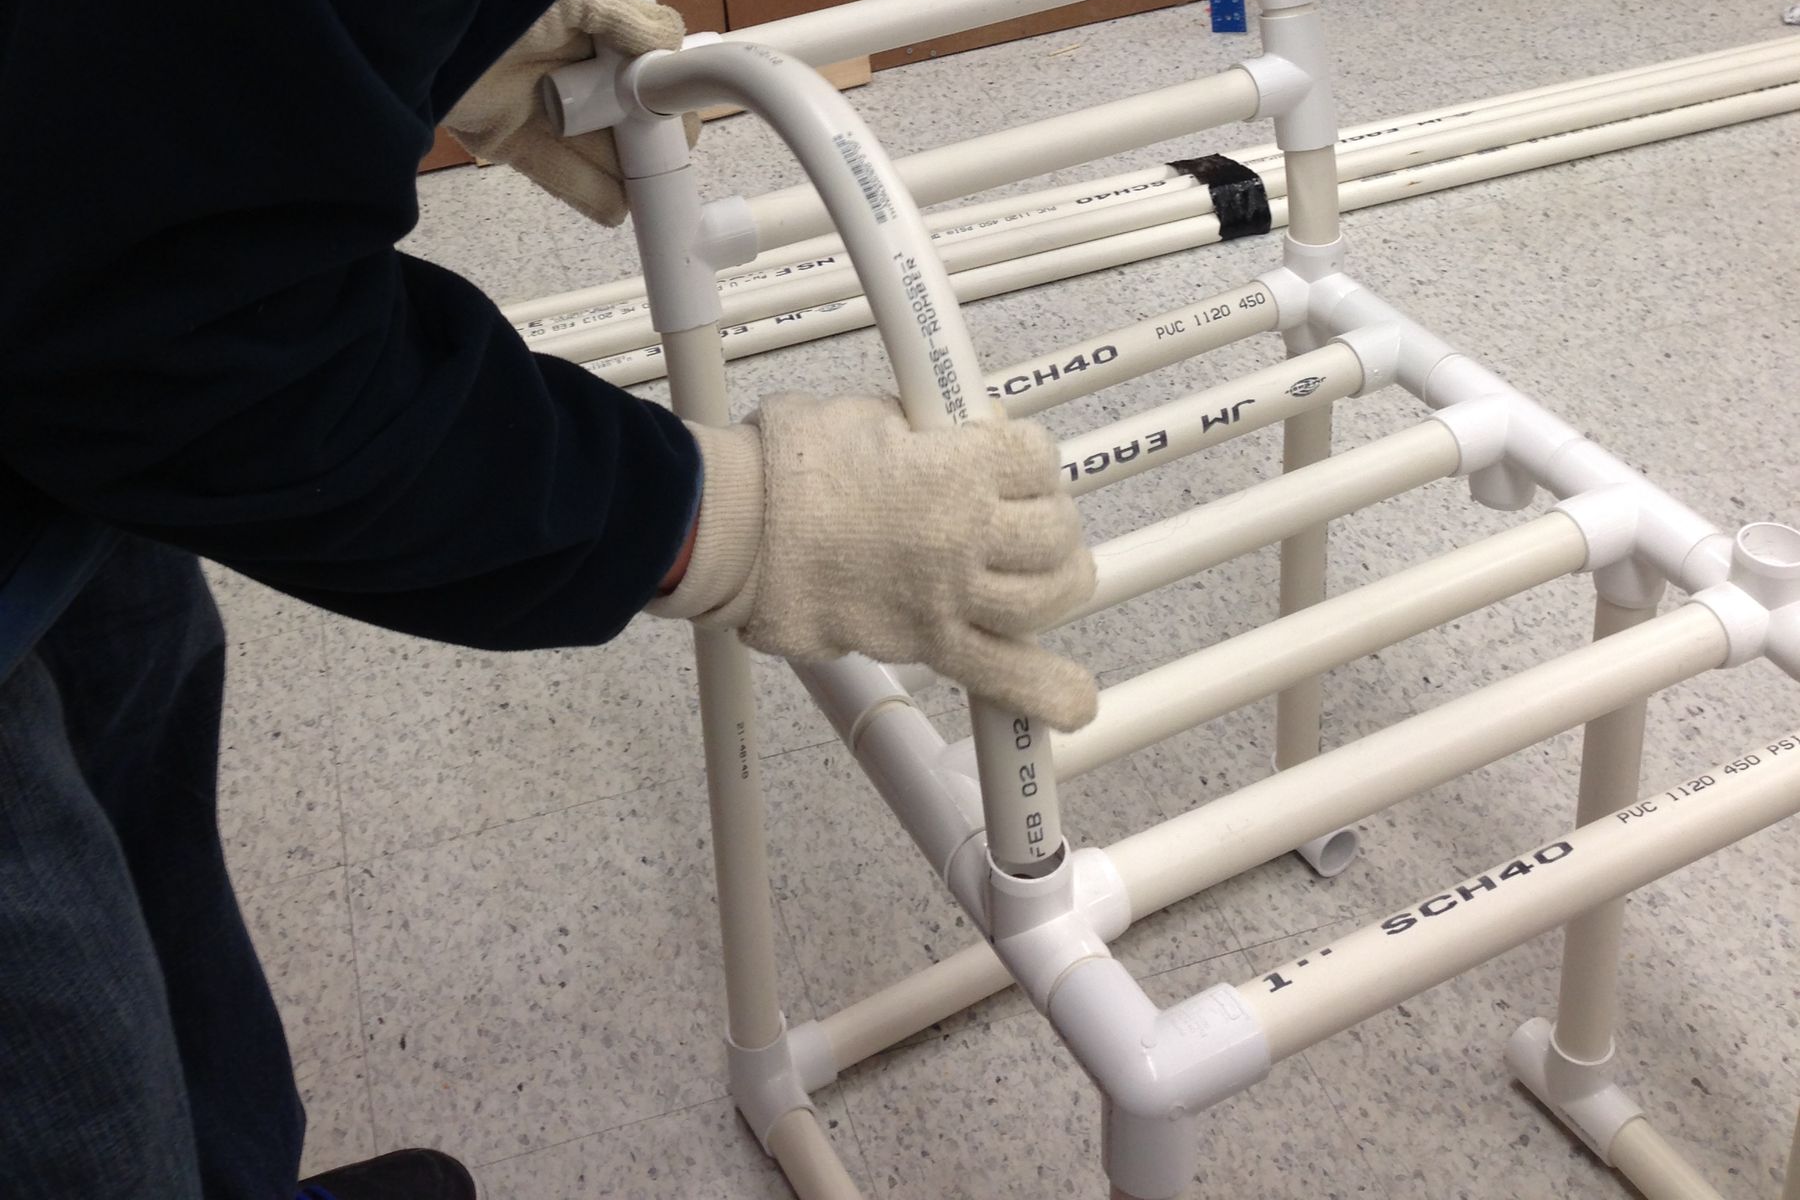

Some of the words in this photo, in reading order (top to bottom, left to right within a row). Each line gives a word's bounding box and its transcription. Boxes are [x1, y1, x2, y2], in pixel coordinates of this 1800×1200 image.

[906, 257, 941, 333] NUMBER
[1156, 320, 1185, 340] PVC
[1193, 304, 1231, 327] 1120
[1238, 292, 1266, 310] 450
[939, 346, 968, 420] ARCODE
[1201, 399, 1256, 434] JM
[1061, 429, 1168, 482] EAGL
[1019, 762, 1038, 798] 02
[1026, 811, 1046, 858] FEB
[1380, 841, 1574, 935] SCH40
[1616, 801, 1658, 824] PVC
[1665, 775, 1716, 801] 1120
[1724, 754, 1761, 775] 450
